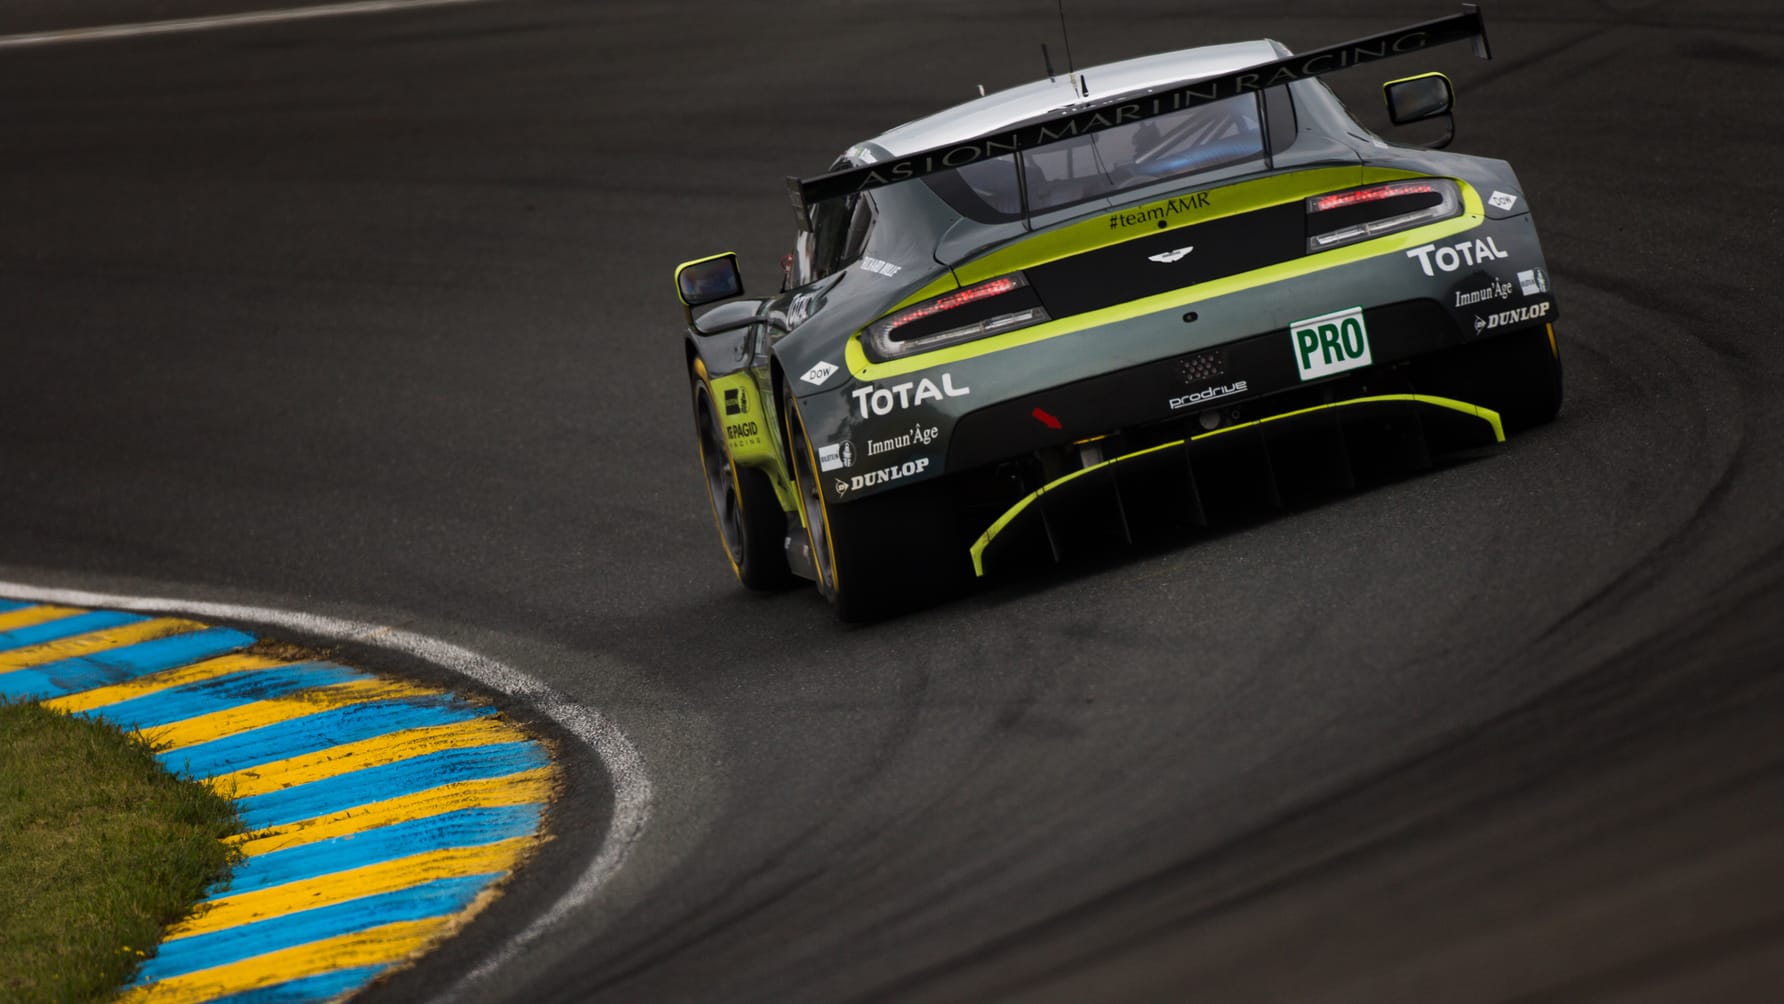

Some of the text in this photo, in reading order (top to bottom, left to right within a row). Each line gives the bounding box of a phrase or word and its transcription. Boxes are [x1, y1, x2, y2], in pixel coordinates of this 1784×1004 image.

[1235, 31, 1430, 93] RACING
[1110, 191, 1211, 230] #teamAMR
[1406, 236, 1509, 276] TOTAL
[1487, 302, 1550, 328] DUNLOP
[1296, 317, 1365, 370] PRO
[809, 367, 831, 380] DOW
[852, 373, 970, 419] TOTAL
[1169, 380, 1248, 409] prodrive
[851, 457, 929, 491] DUNLOP
